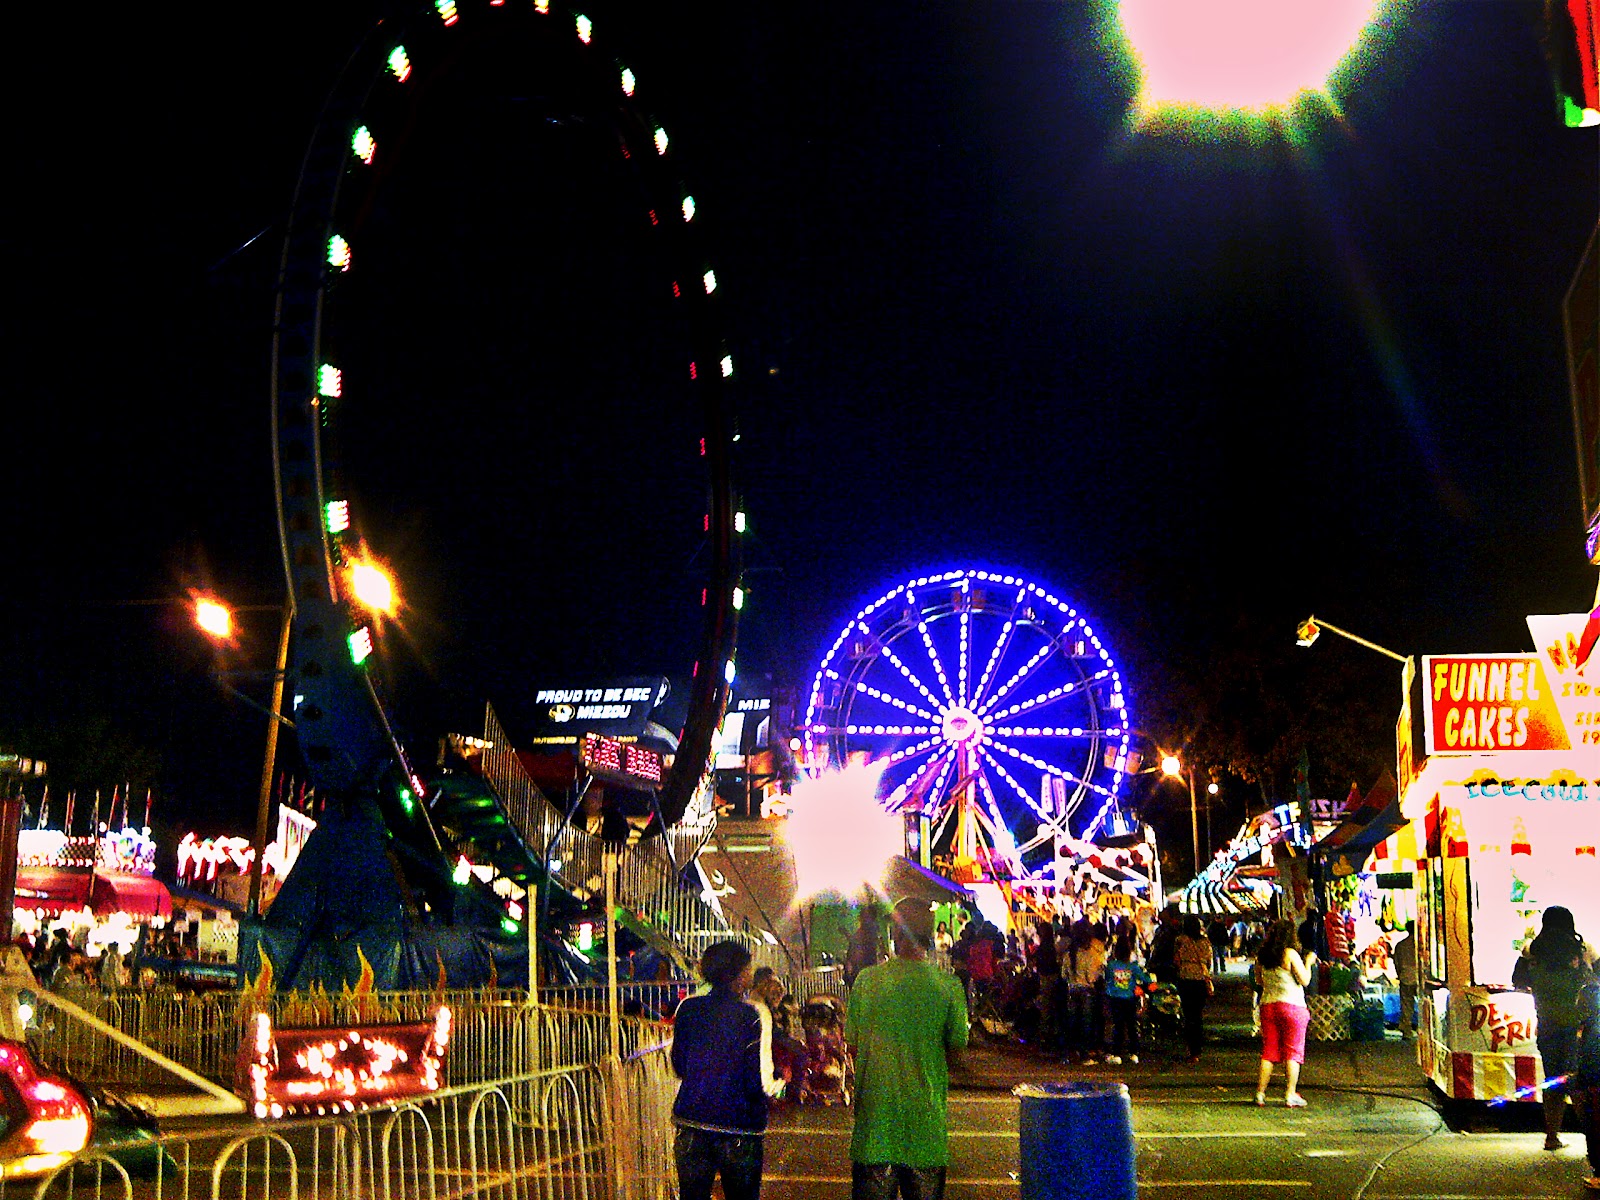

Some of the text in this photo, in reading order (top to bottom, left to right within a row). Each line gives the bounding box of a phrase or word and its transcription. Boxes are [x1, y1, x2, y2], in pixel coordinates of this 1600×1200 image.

[536, 688, 651, 704] PROUD TO BE SEC
[1434, 662, 1540, 702] FUNNEL
[576, 705, 631, 719] MIZZOU
[1445, 707, 1529, 749] CAKES
[1490, 1020, 1538, 1053] FRI
